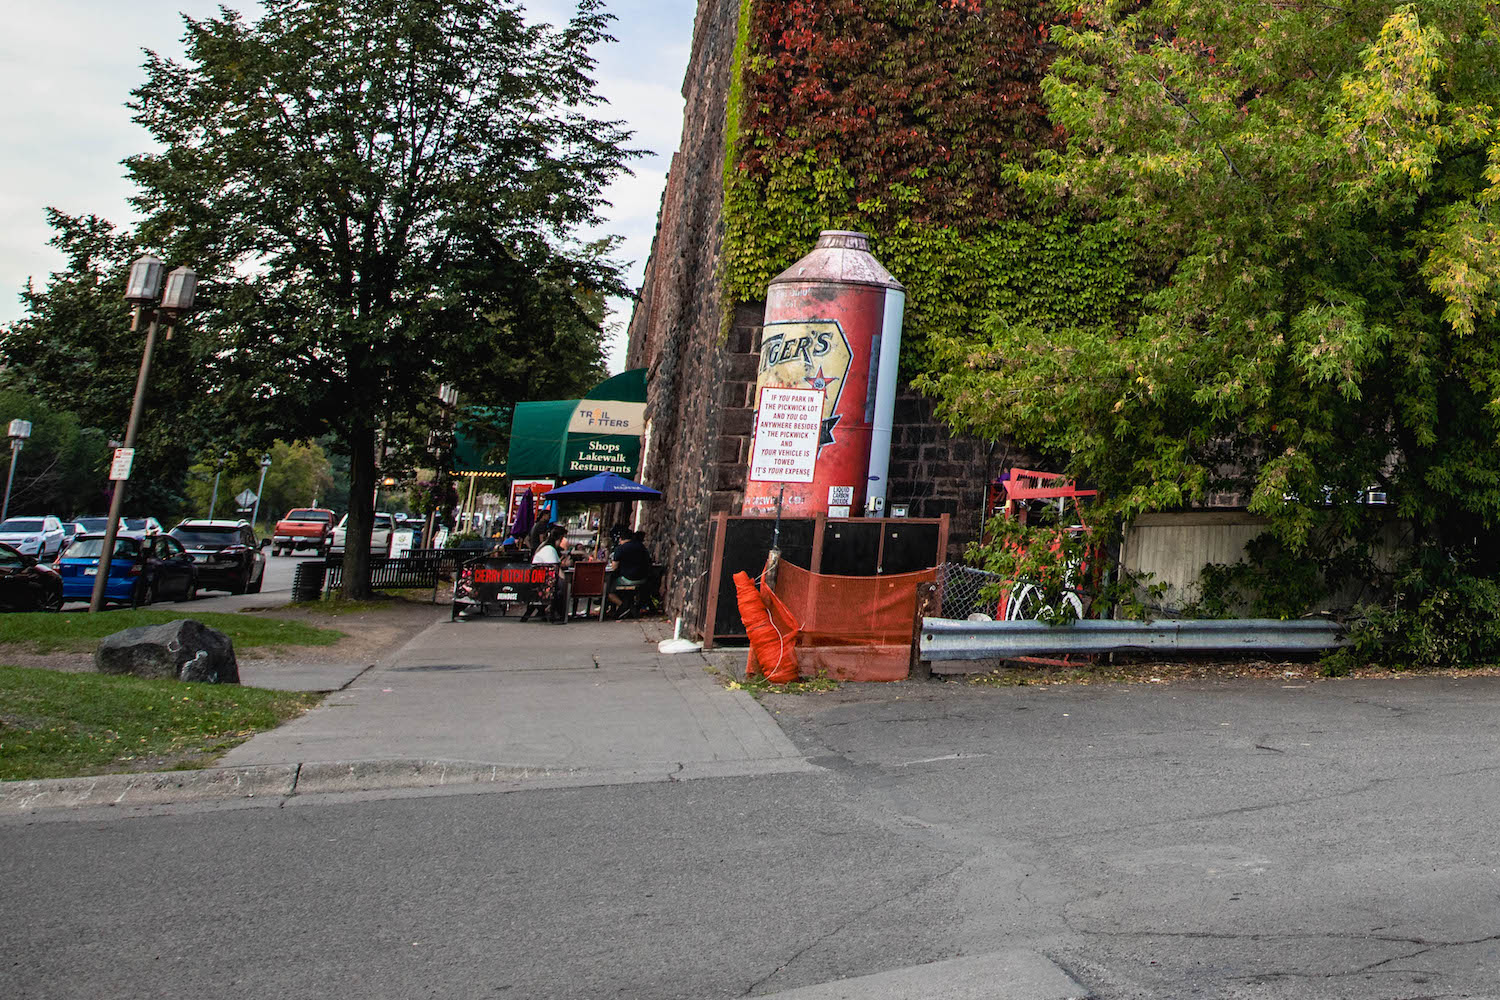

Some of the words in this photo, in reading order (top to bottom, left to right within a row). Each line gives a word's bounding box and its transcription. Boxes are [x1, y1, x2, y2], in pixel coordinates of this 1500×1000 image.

[779, 394, 791, 402] YOU
[792, 395, 807, 403] PARK
[777, 403, 806, 412] PICKWICK
[760, 421, 792, 429] ANYWHERE
[793, 422, 818, 430] BESIDES
[767, 430, 778, 438] THE
[779, 431, 809, 439] PICKWICK
[588, 440, 621, 454] Shops
[578, 451, 627, 463] Lakewalk
[761, 448, 777, 456] YOUR
[778, 449, 802, 457] VEHICLE
[774, 458, 795, 466] TOWED
[569, 460, 632, 474] Restaurants
[755, 466, 767, 474] IT'S
[768, 467, 784, 475] YOUR
[784, 468, 810, 476] EXPENSE
